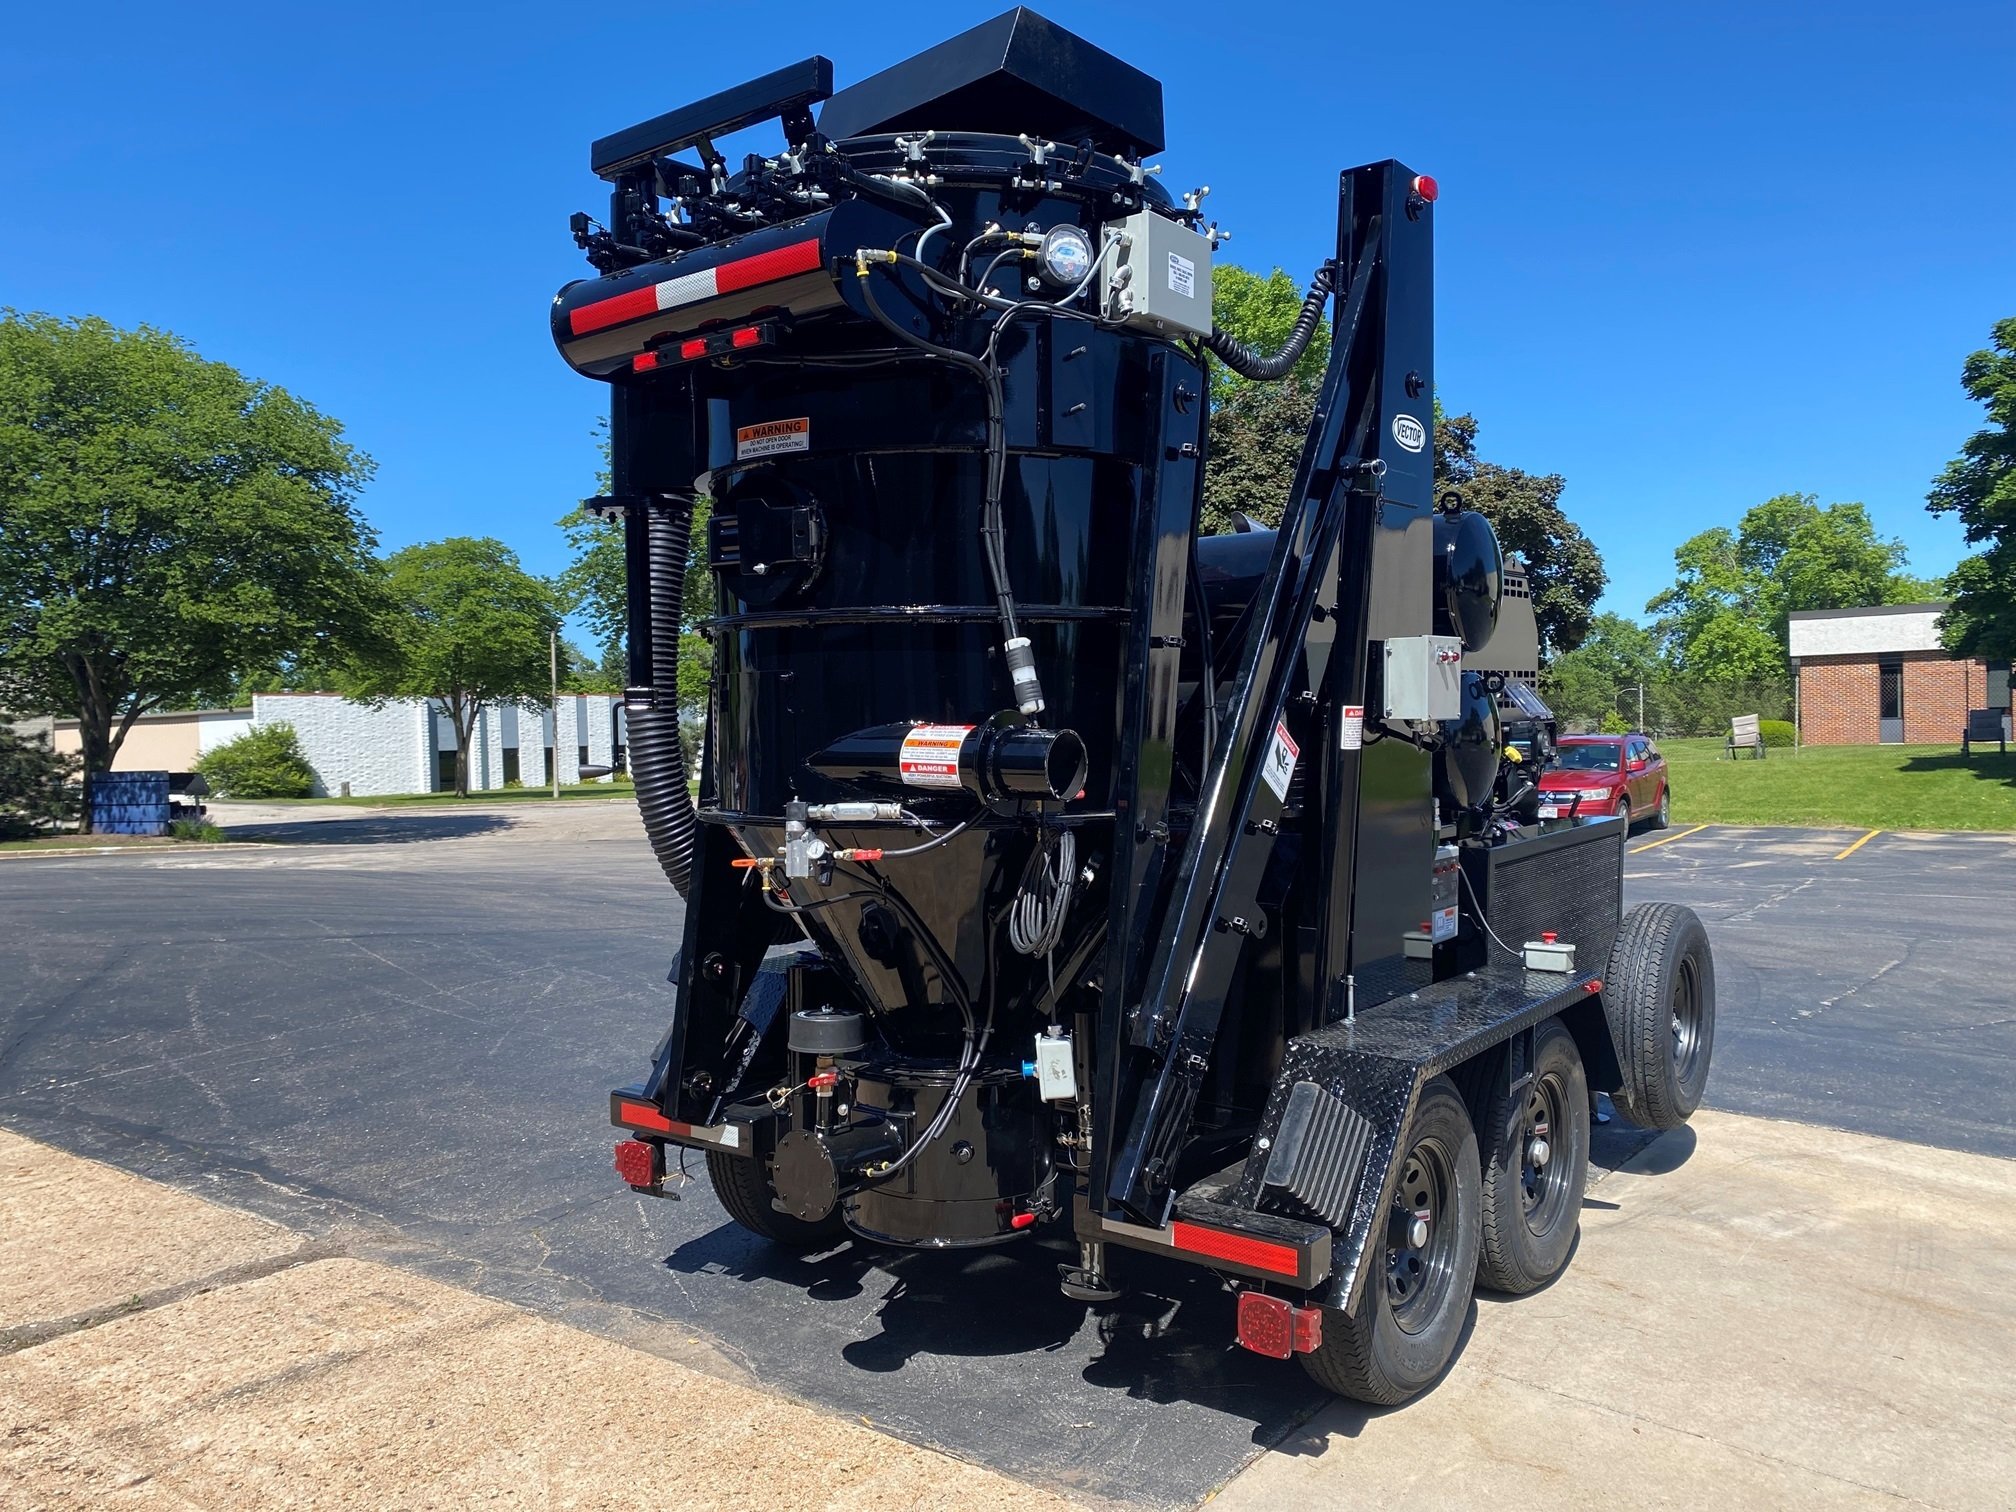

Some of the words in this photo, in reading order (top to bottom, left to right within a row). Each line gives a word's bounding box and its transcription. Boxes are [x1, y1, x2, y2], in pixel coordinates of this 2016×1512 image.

[752, 421, 801, 437] WARNING
[1397, 420, 1422, 444] VECTOR
[753, 445, 770, 453] MACHINE
[918, 764, 948, 772] DANGER
